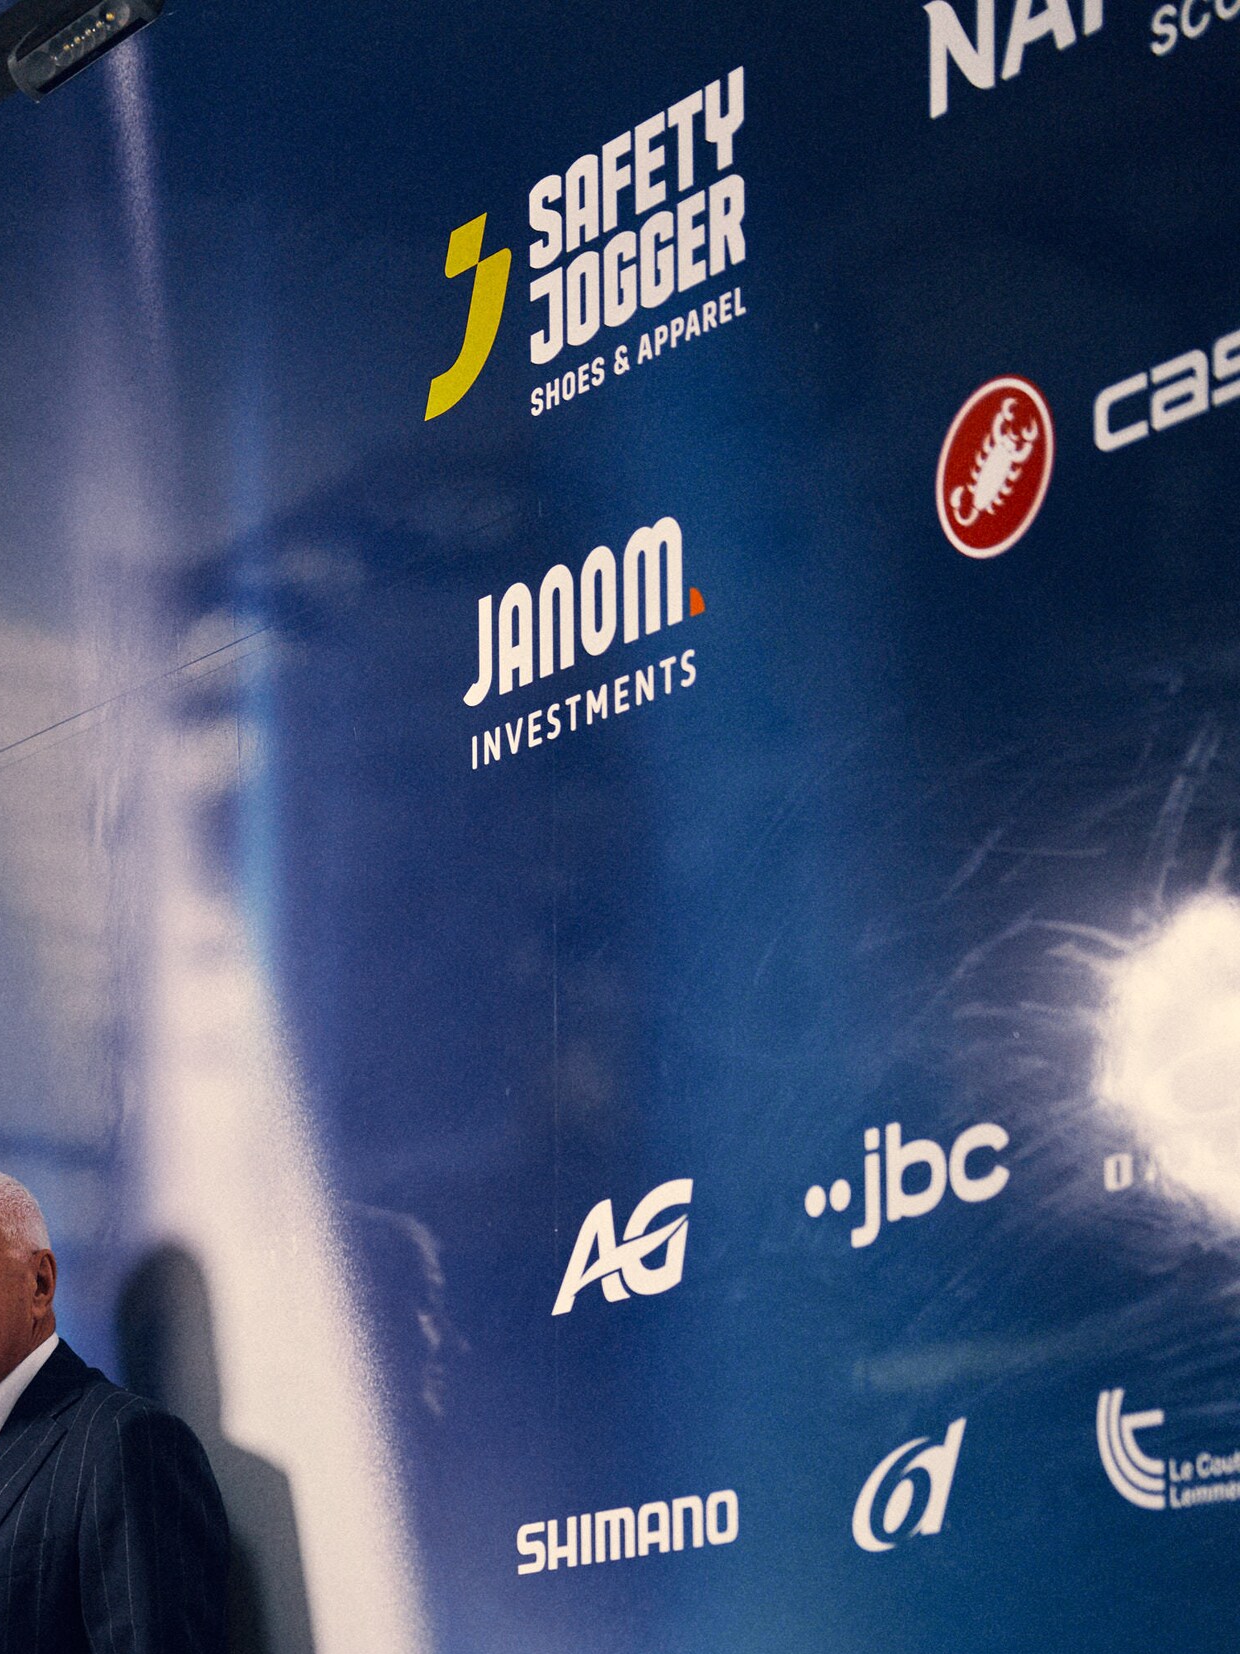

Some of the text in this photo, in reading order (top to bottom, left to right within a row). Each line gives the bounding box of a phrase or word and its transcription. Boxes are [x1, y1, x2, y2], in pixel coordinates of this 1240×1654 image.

[529, 65, 745, 269] SAFETY
[529, 174, 746, 365] JOGGER
[530, 287, 747, 416] SHOES & APPAREL
[471, 648, 696, 770] INVESTMENTS
[516, 1489, 739, 1576] SHIMANO
